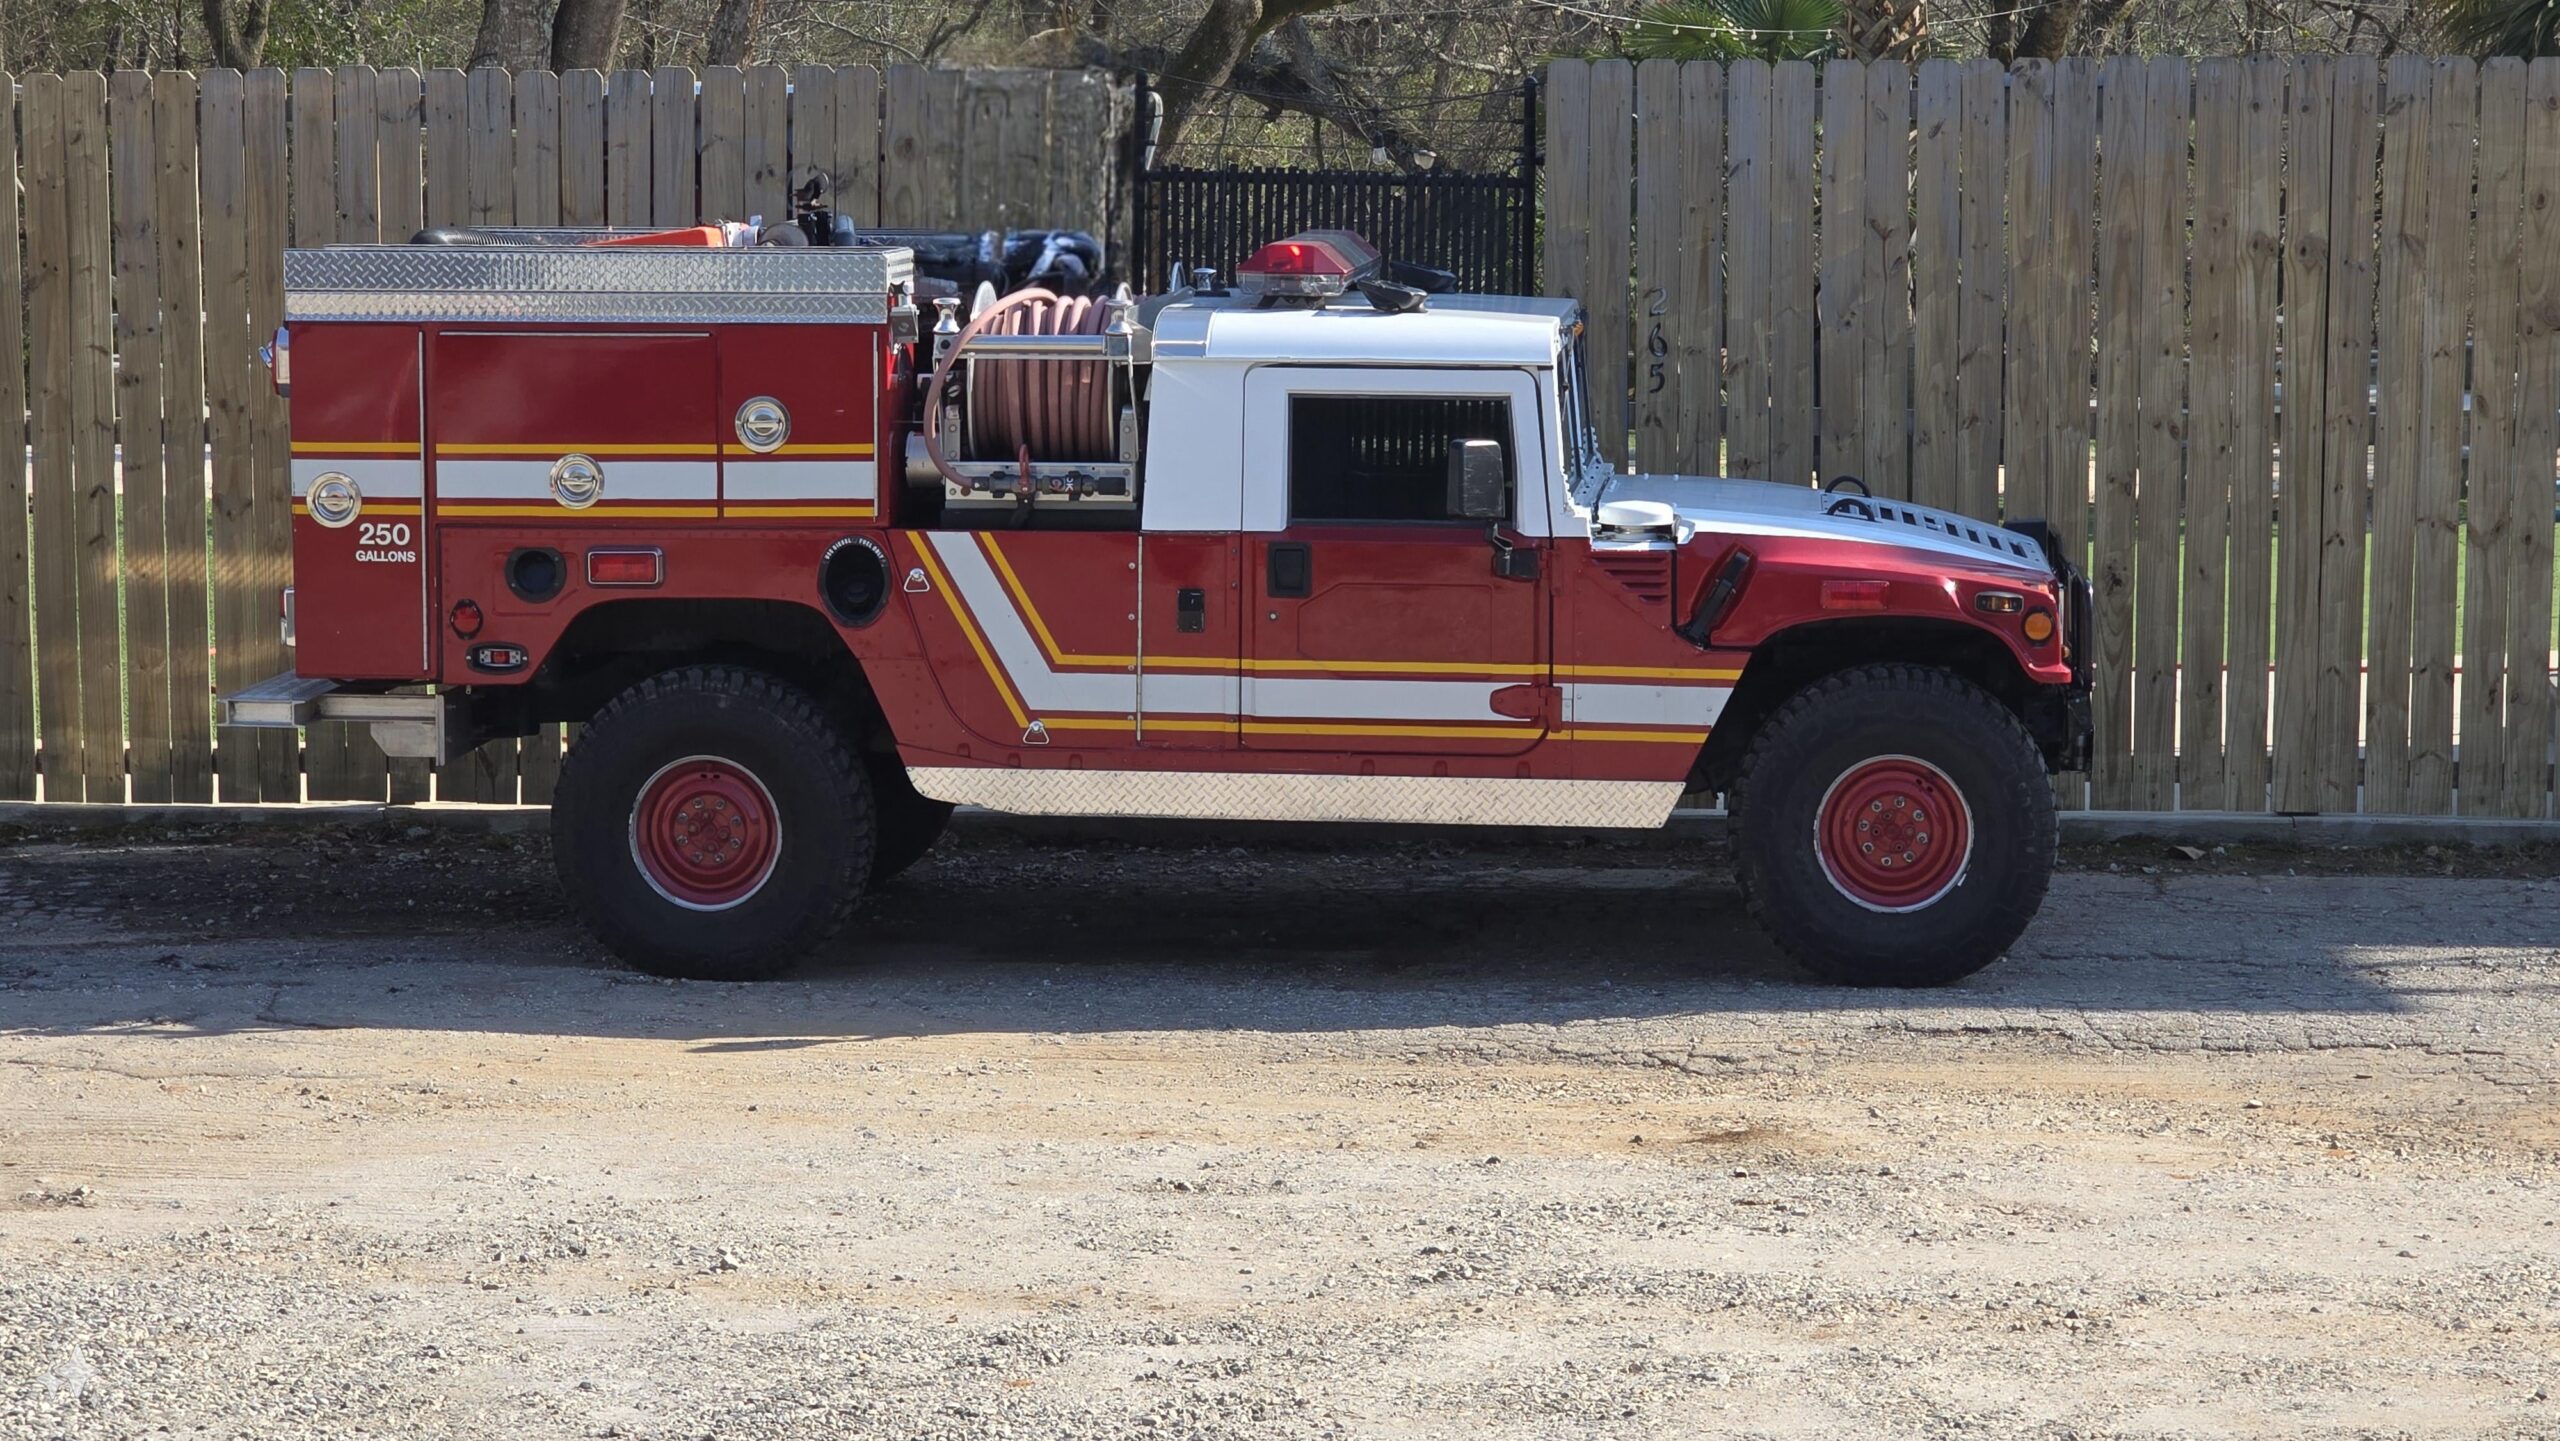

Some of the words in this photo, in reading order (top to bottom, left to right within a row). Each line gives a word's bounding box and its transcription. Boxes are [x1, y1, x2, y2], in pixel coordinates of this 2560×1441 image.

[1643, 287, 1668, 394] 265
[359, 523, 411, 546] 250
[355, 550, 416, 563] GALLONS
